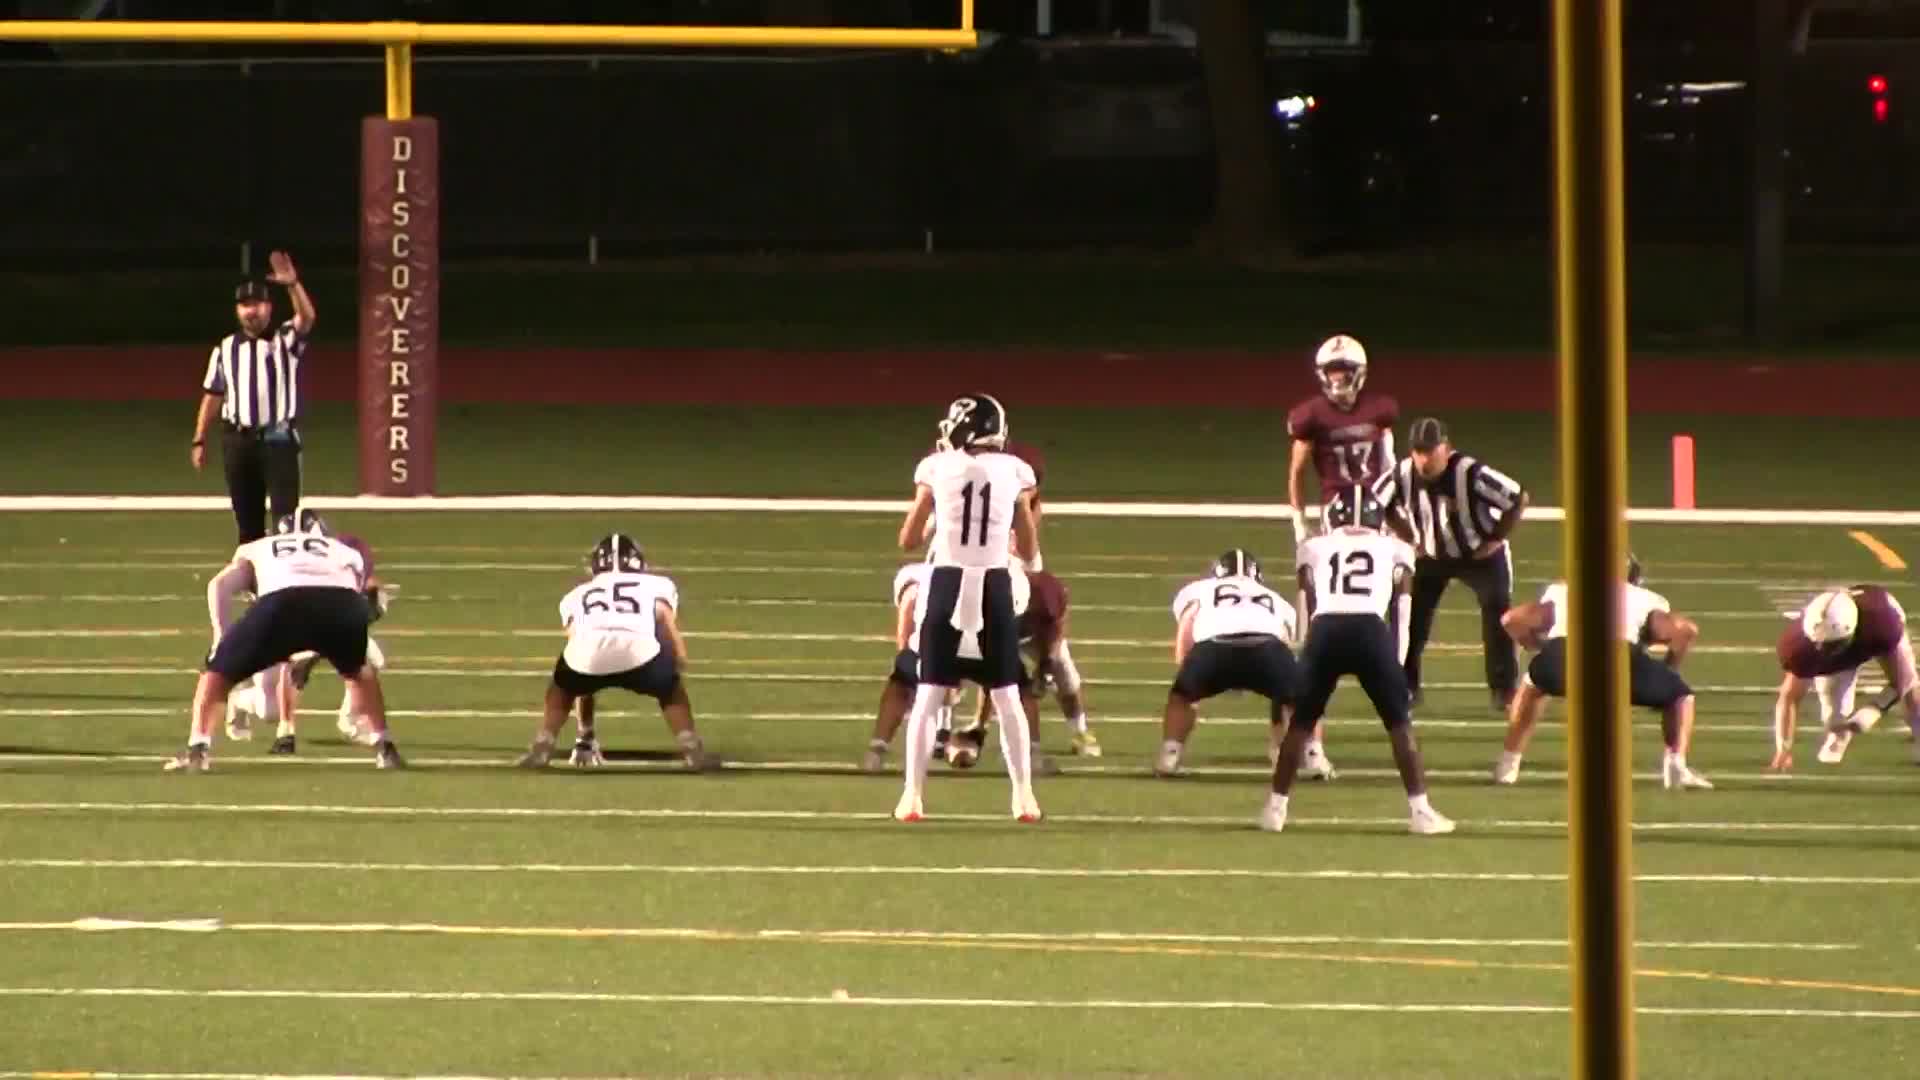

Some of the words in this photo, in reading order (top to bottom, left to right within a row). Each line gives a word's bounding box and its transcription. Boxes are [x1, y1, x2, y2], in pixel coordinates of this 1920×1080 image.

[390, 136, 412, 483] DISCOVERERS
[1334, 441, 1373, 481] 17
[961, 481, 991, 546] 11
[1329, 551, 1374, 597] 12
[582, 581, 641, 615] 65
